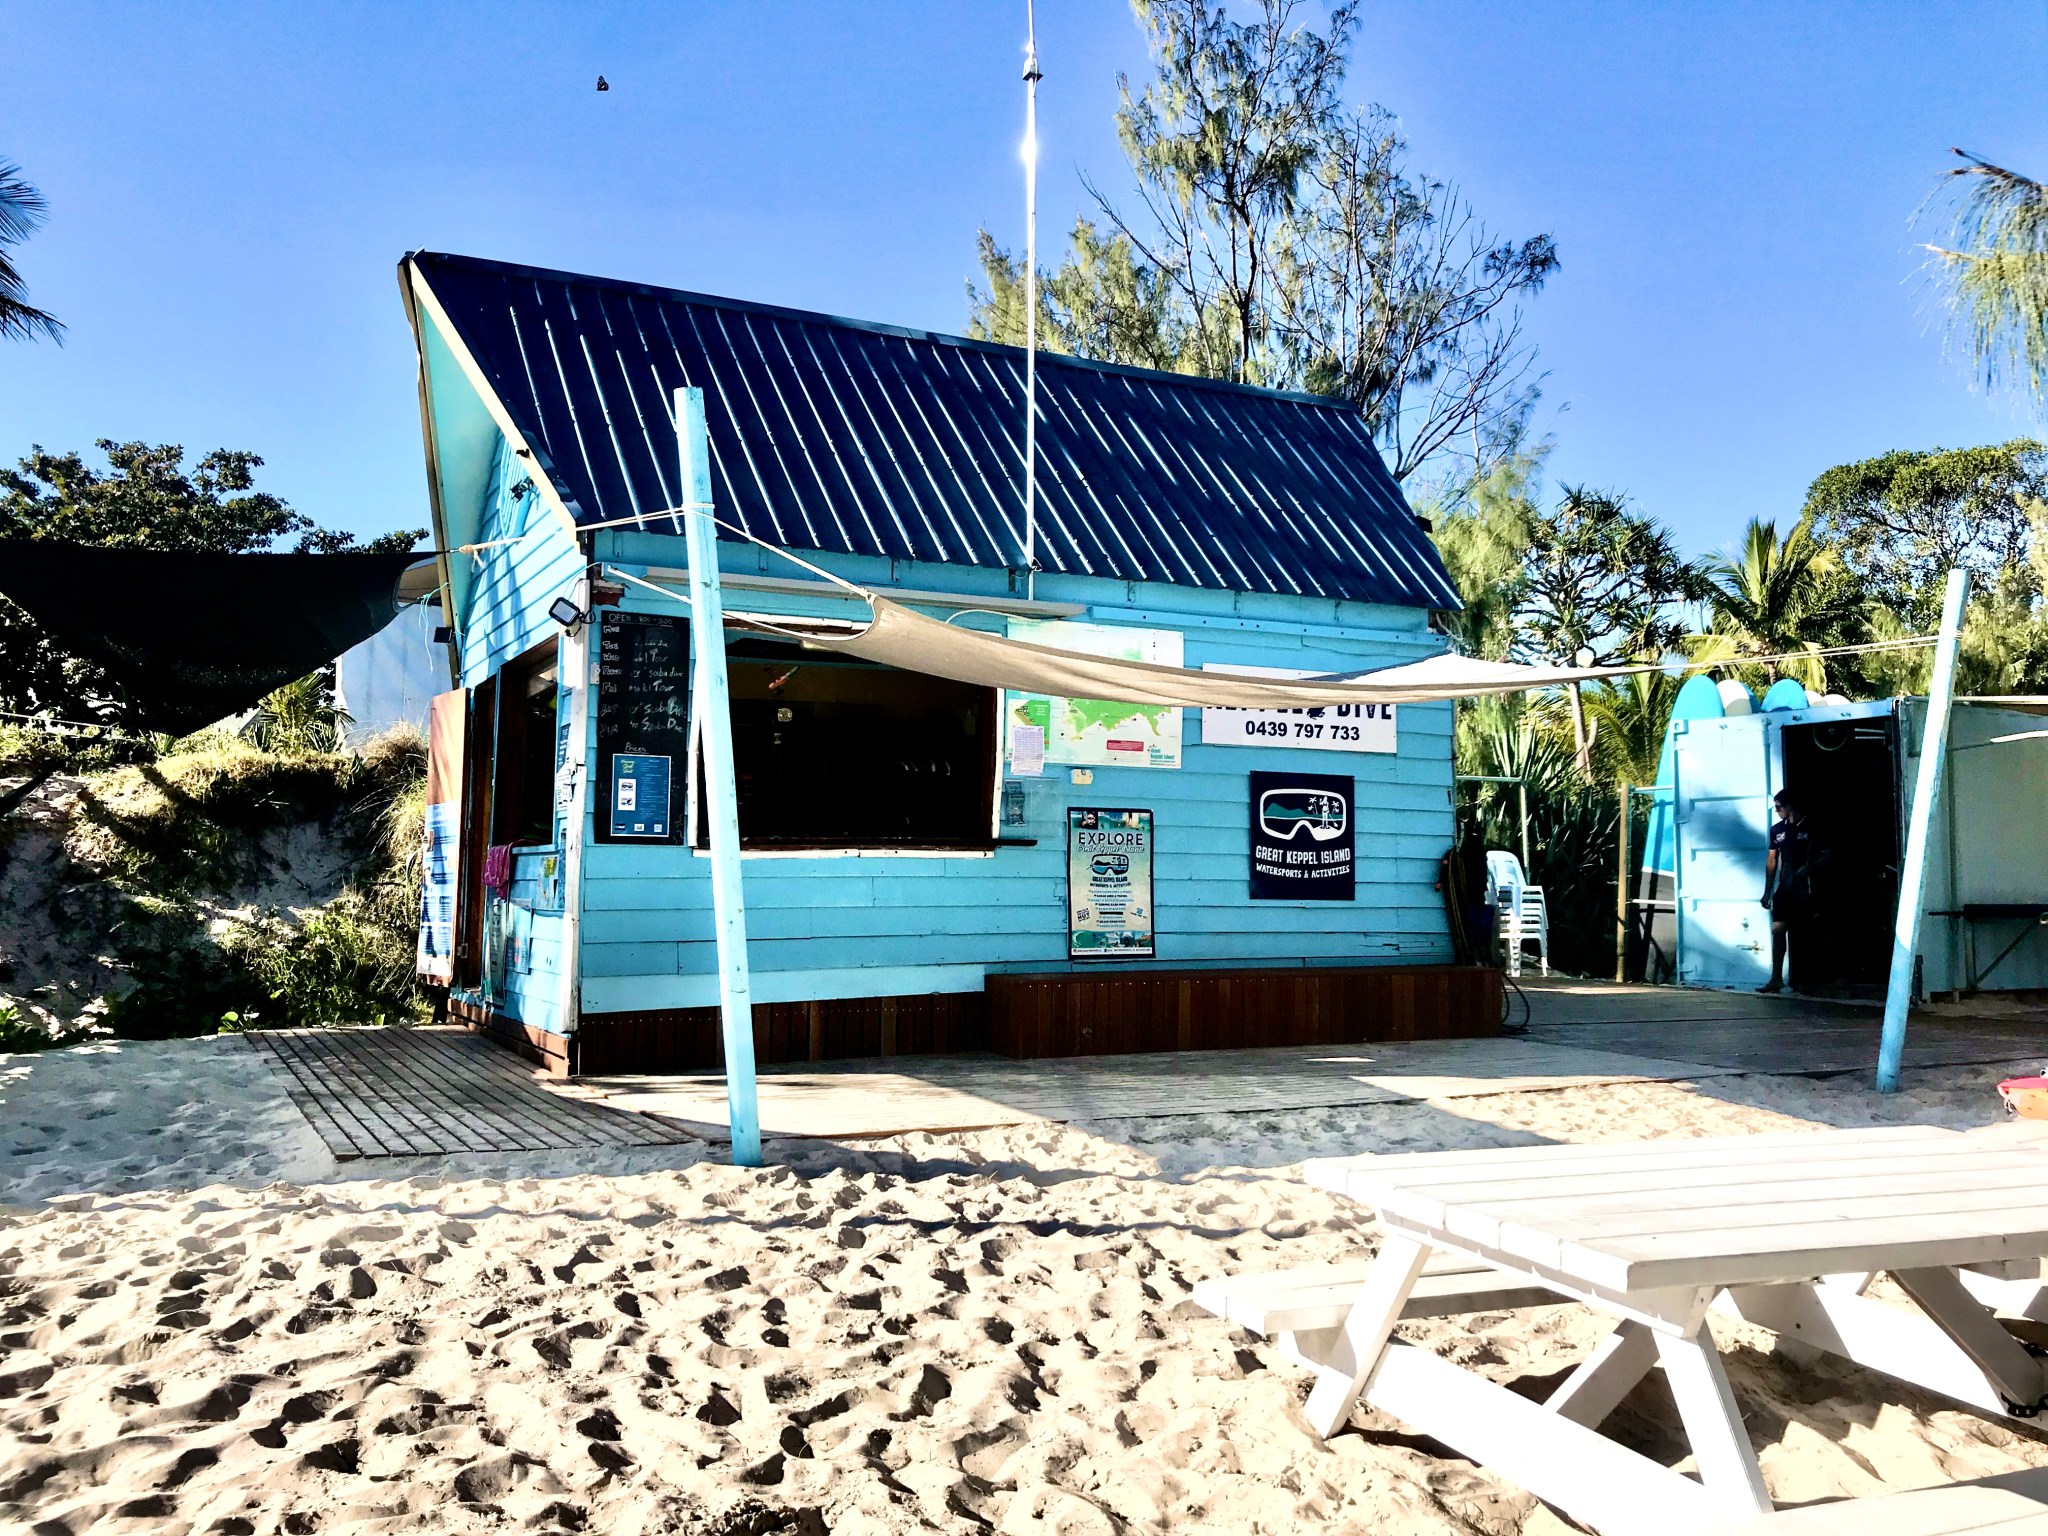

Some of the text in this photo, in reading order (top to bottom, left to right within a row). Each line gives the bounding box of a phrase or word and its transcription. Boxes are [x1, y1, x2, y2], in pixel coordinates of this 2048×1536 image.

[608, 613, 631, 622] OPEN
[1245, 720, 1360, 741] 0439 797 733
[1078, 832, 1144, 846] EXPLORE
[1255, 845, 1351, 864] GREAT KEPPEL ISLAND
[1256, 862, 1350, 878] WATERSPORTS & ACTIVITIES
